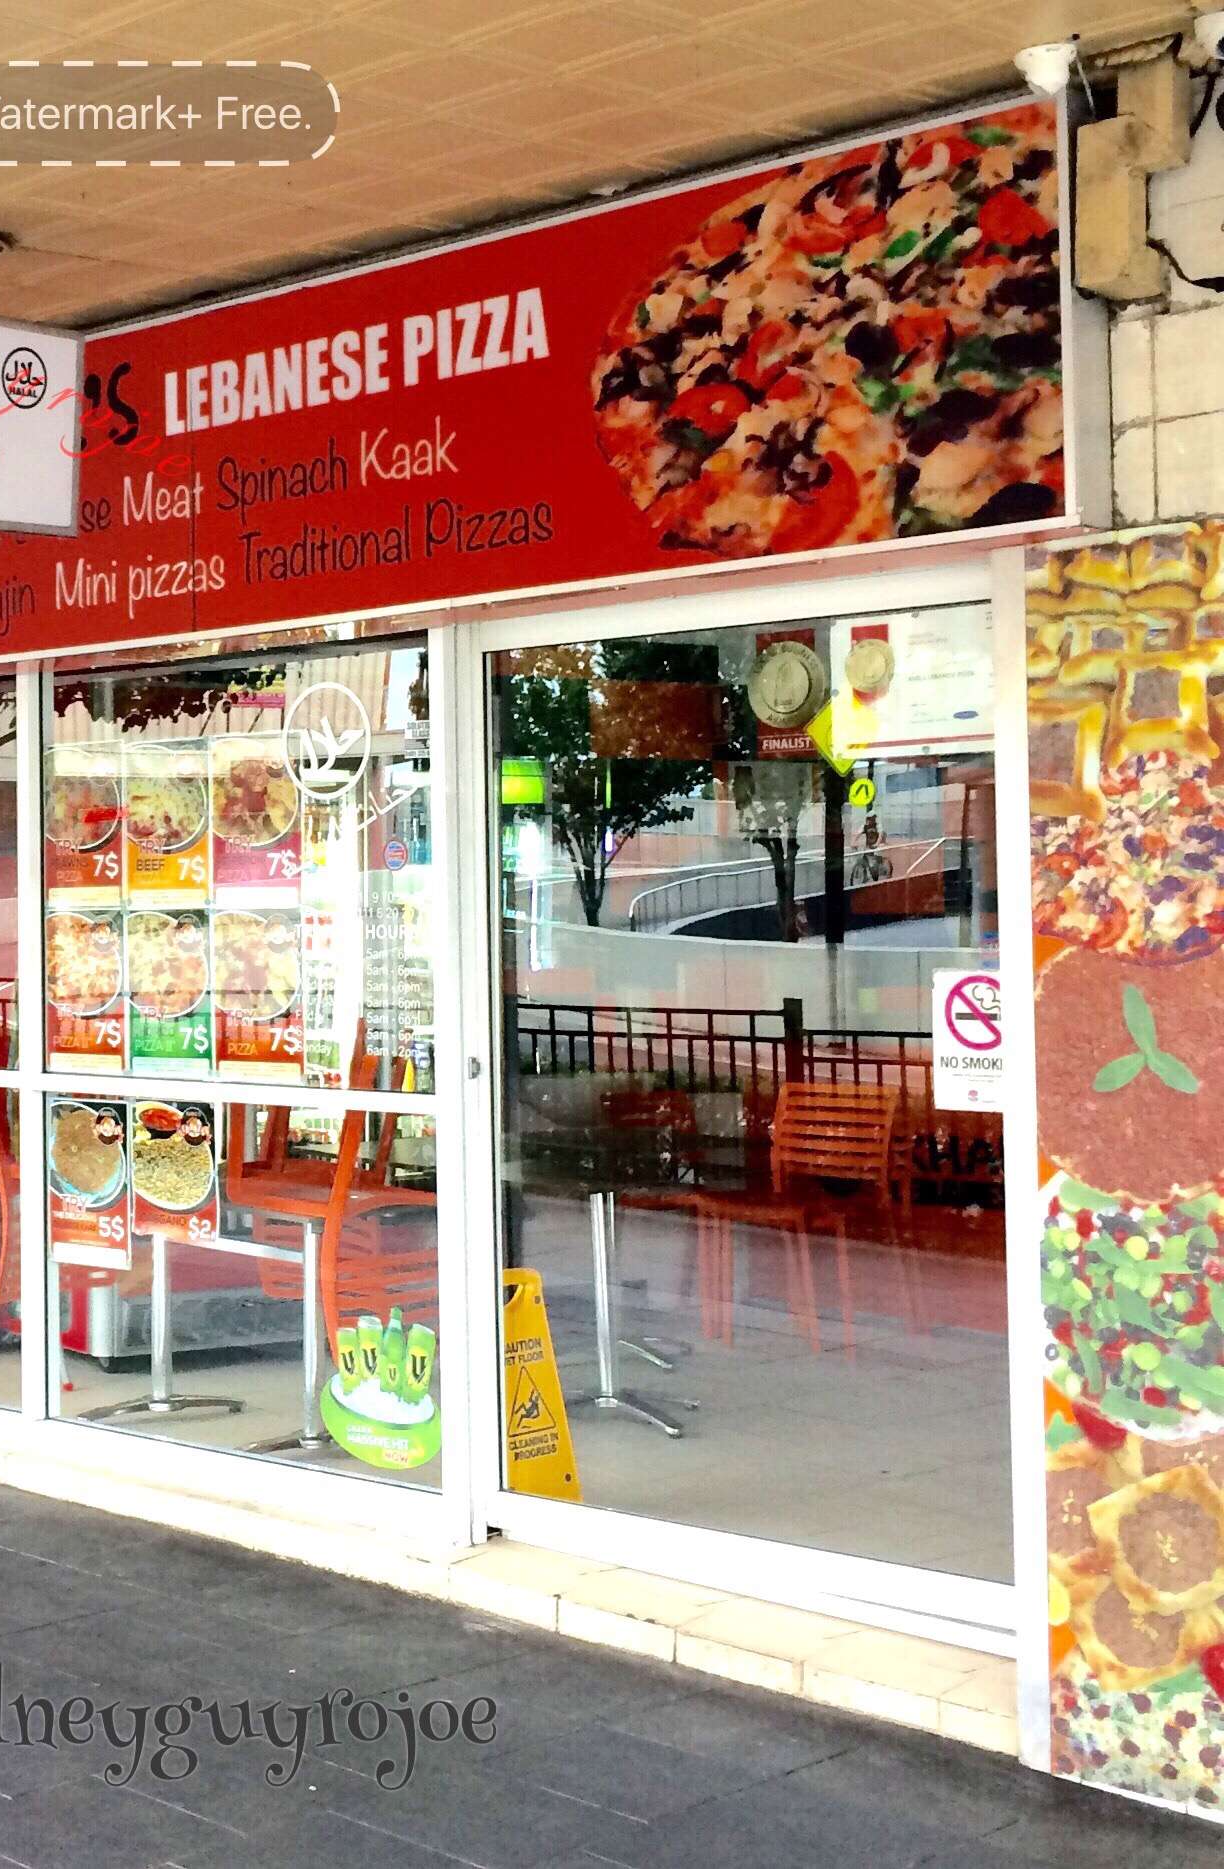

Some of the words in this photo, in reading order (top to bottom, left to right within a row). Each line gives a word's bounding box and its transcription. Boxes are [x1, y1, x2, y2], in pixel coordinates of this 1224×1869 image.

[165, 322, 390, 437] LEBANESE
[403, 287, 550, 388] PIZZA
[123, 471, 205, 527] Meat
[217, 436, 348, 527] Spinach
[360, 415, 459, 487] Kaak
[56, 556, 117, 610] Mini
[128, 554, 226, 620] pizzas
[240, 505, 411, 585] Traditional
[425, 497, 553, 559] Pizzas
[762, 737, 811, 751] FINALIST
[93, 851, 119, 879] 7$
[136, 858, 166, 872] BEEF
[177, 855, 206, 884] 7$
[366, 924, 417, 940] HOUR
[95, 1019, 121, 1048] 7$
[179, 1024, 209, 1053] 7$
[269, 1025, 297, 1055] 7$
[228, 1042, 258, 1056] PIZZA
[941, 1056, 958, 1068] NO
[962, 1057, 1002, 1070] SMOKI
[98, 1216, 125, 1241] 5$
[505, 1338, 542, 1354] AUTION
[519, 1351, 544, 1363] FLOOR
[509, 1435, 549, 1451] CLEANING
[514, 1444, 557, 1461] PROGRESS
